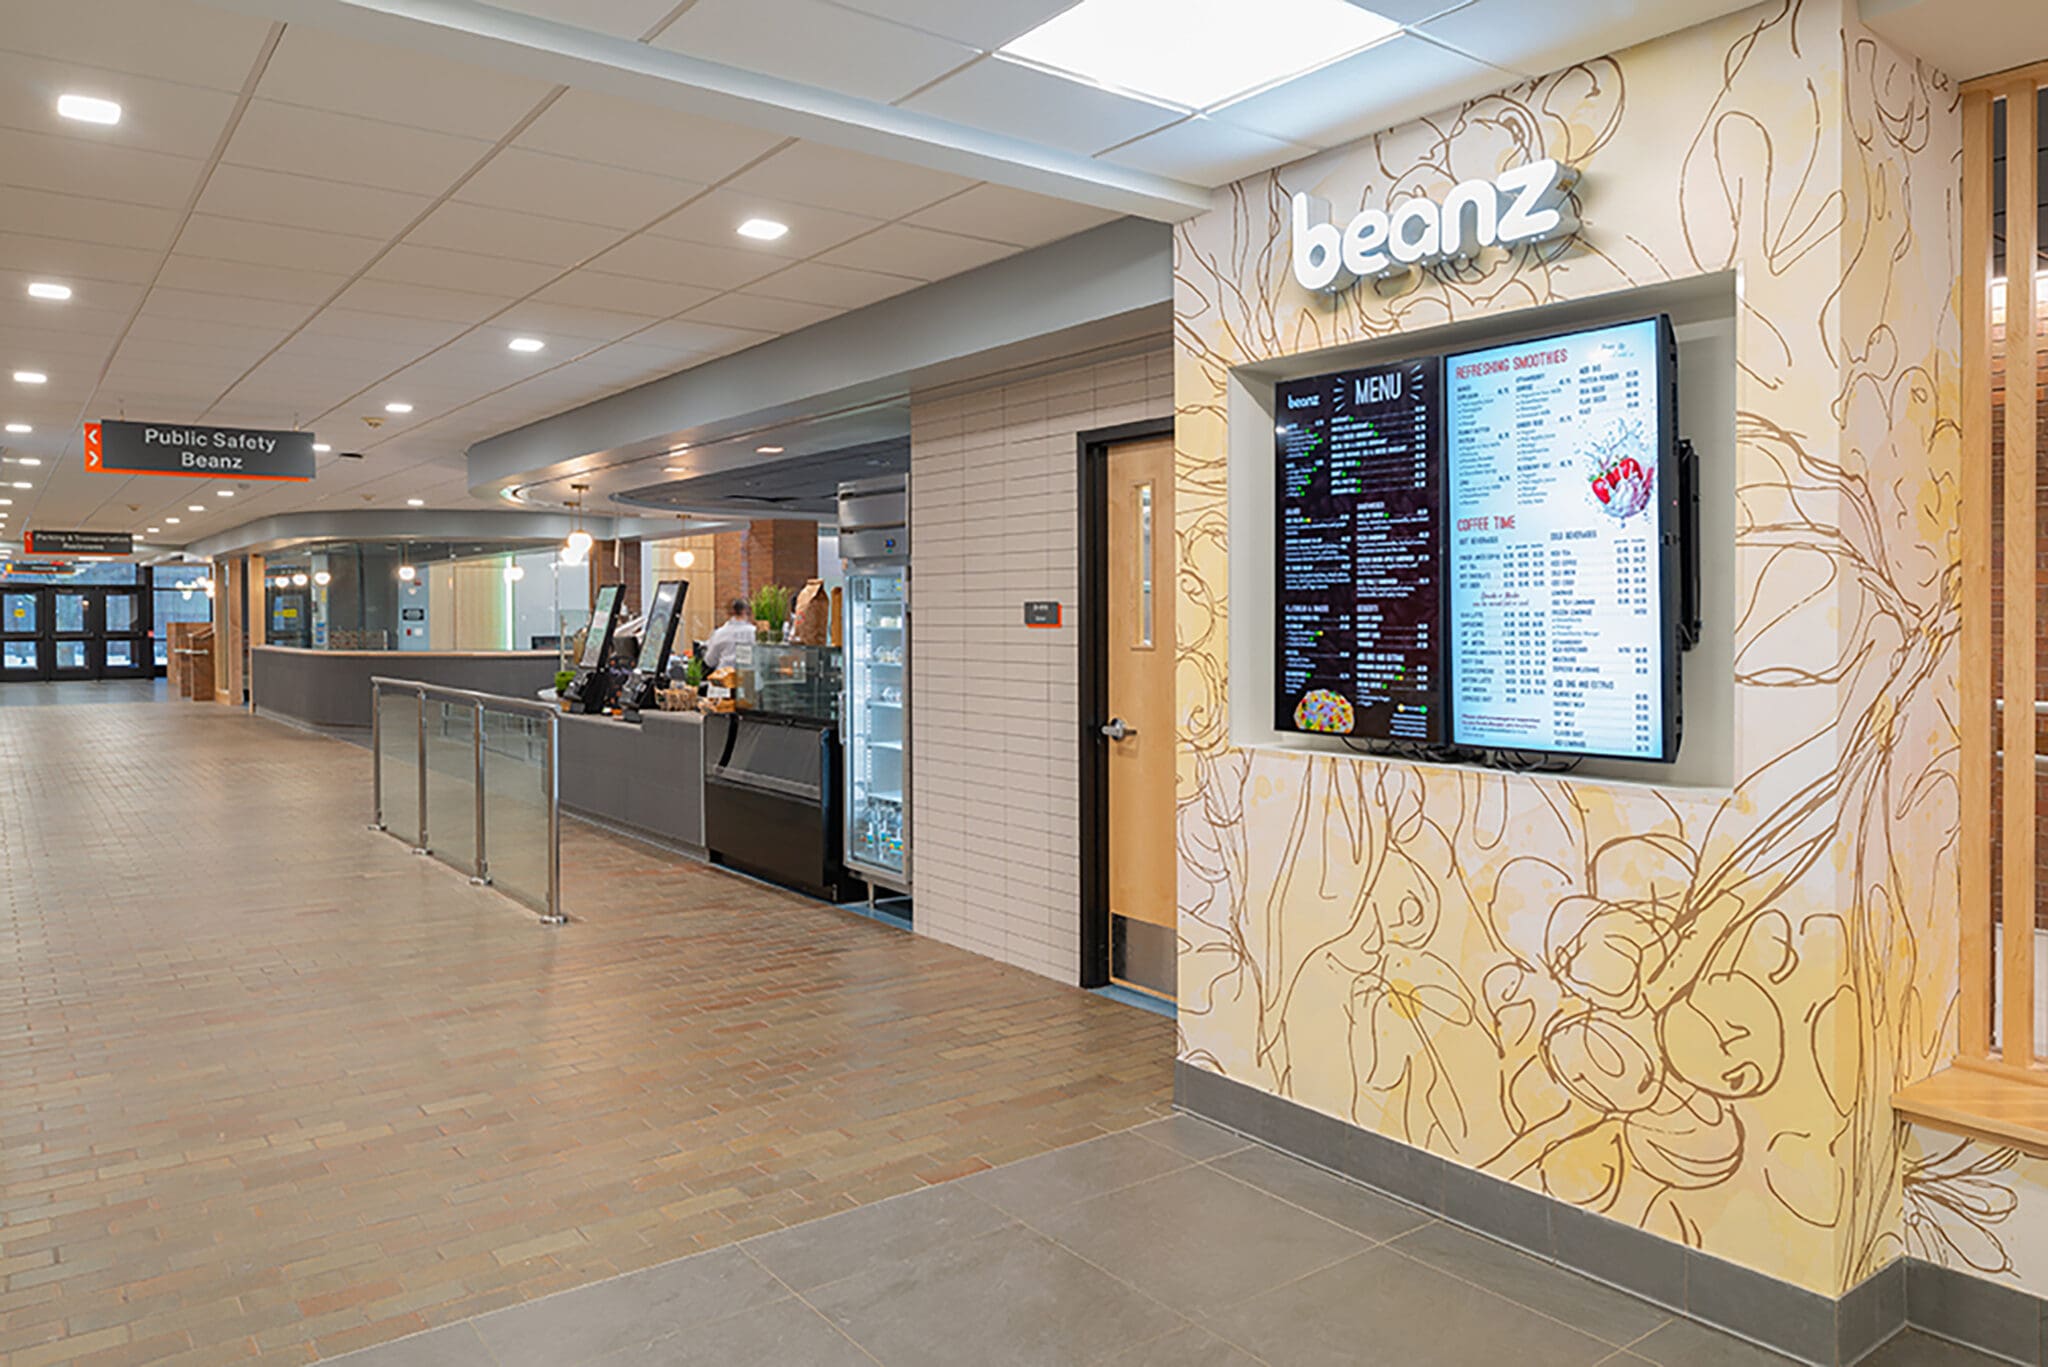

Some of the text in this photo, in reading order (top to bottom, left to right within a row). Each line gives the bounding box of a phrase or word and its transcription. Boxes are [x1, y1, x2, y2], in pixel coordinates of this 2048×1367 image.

[1291, 158, 1562, 291] beanz
[1455, 347, 1568, 380] REFRESHING SMOOTHIES
[1355, 372, 1402, 405] MENU
[144, 428, 277, 454] Public Safety
[181, 451, 244, 470] Beanz
[1457, 514, 1516, 532] COFFEE TIME
